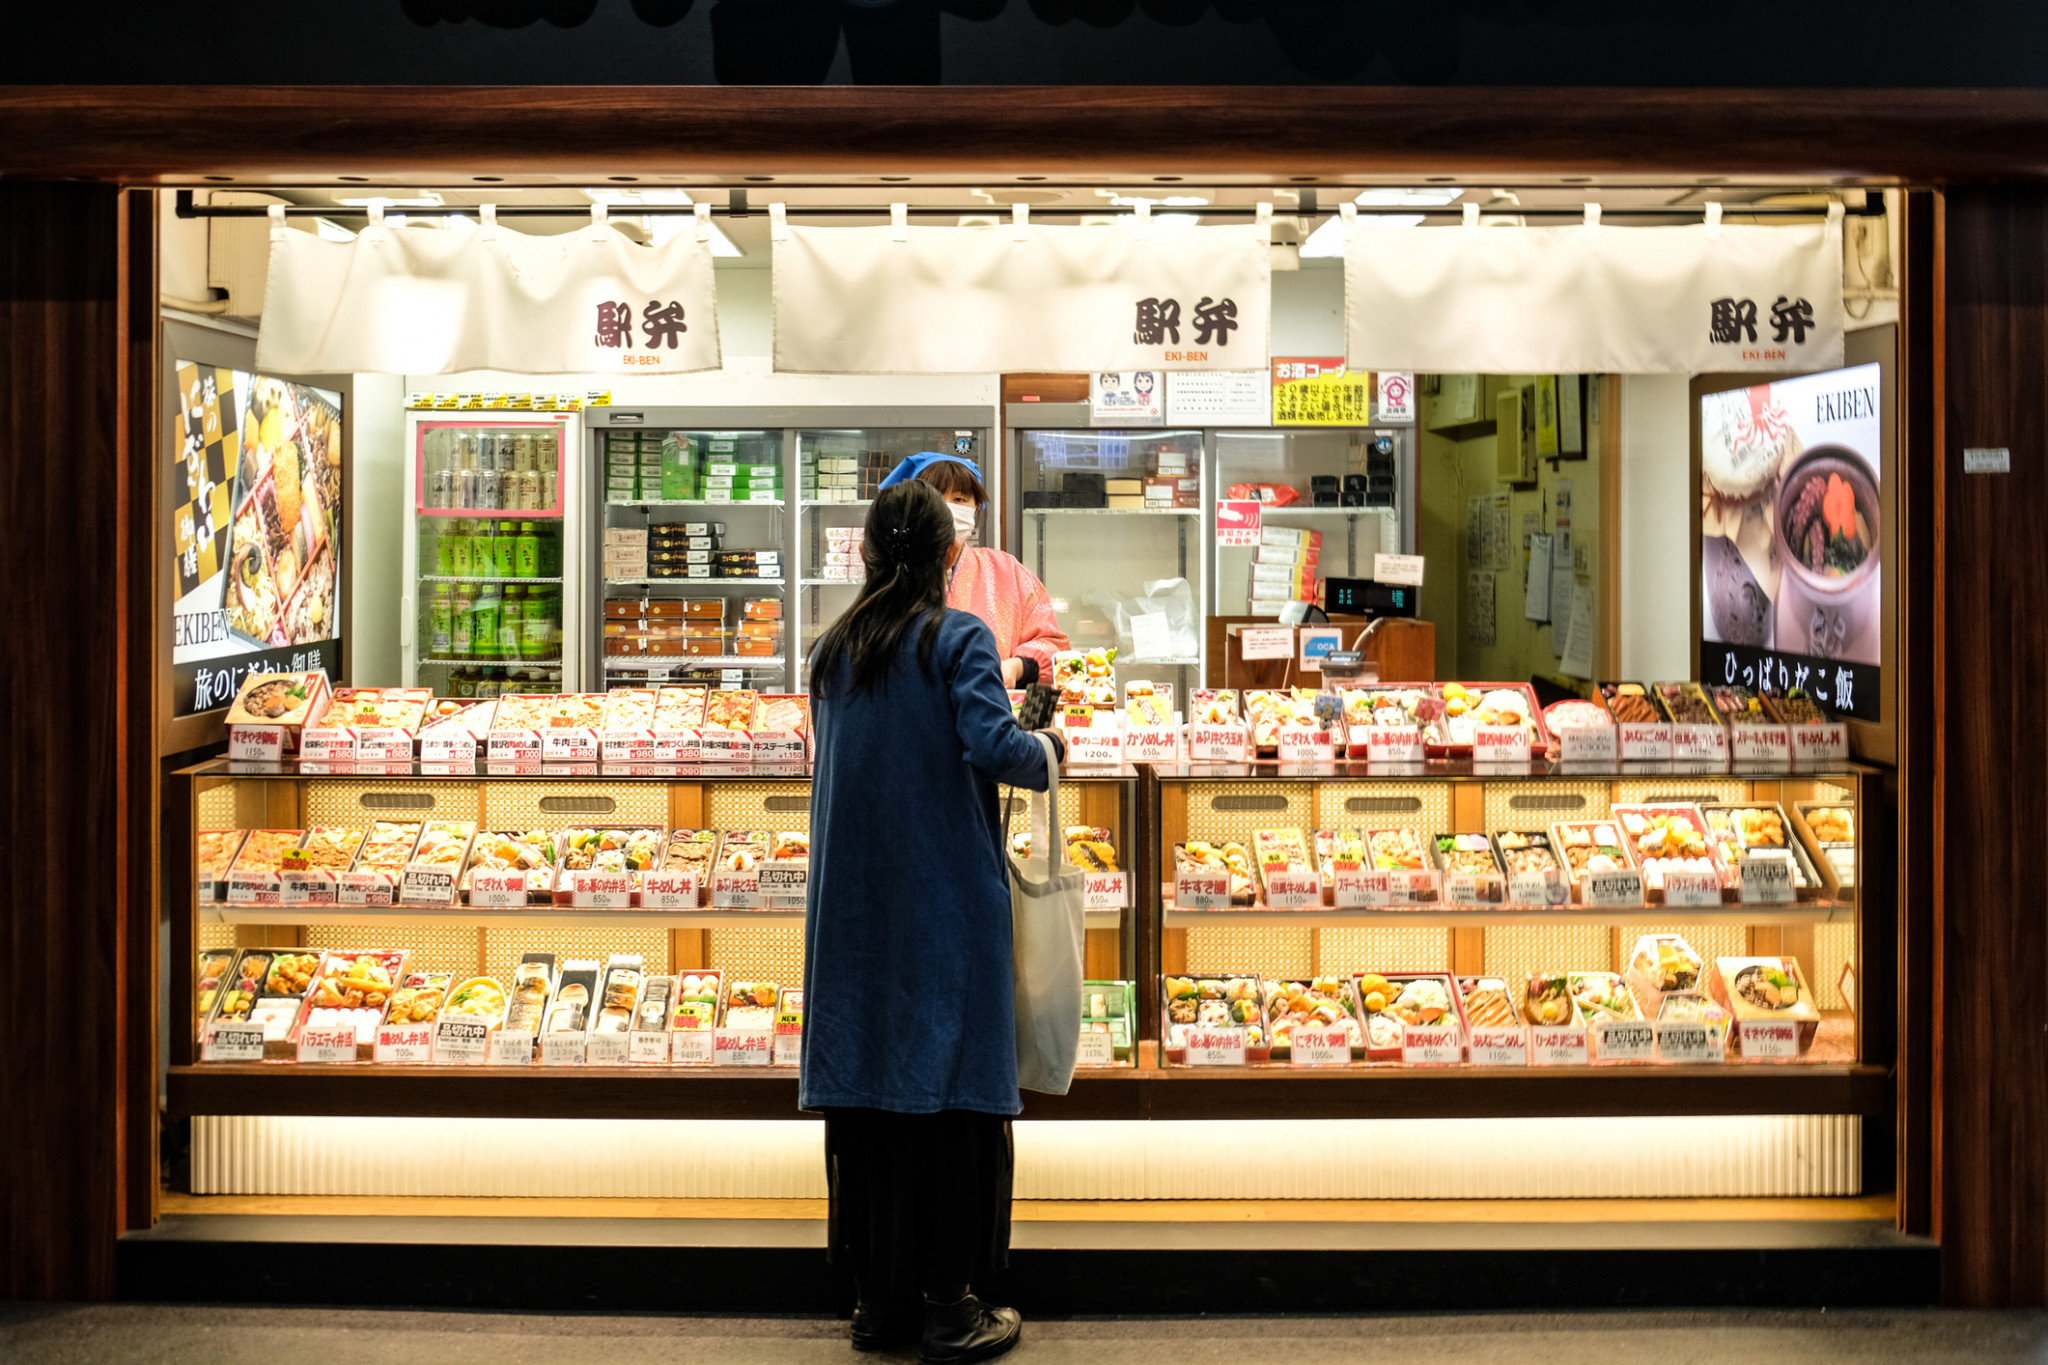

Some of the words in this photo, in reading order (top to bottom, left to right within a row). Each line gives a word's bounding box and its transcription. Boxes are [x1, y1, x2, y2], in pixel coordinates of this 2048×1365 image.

[595, 301, 688, 349] 駅弁
[1134, 297, 1238, 346] 駅弁
[1710, 298, 1815, 344] 駅弁
[624, 355, 660, 365] EKI-BEN
[1165, 352, 1208, 361] EKI-BEN
[1742, 351, 1785, 360] EKI-BEN
[1817, 386, 1875, 424] EKIBEN
[173, 608, 231, 648] EKIBEN
[1725, 652, 1853, 711] ひっぱりだこ飯
[1072, 737, 1119, 746] 春の二段重
[407, 873, 450, 886] 品切れ中
[761, 871, 805, 883] 品切れ中
[647, 879, 692, 894] 牛めし丼
[441, 1024, 485, 1037] 品切れ中
[217, 1032, 261, 1044] 品切れ中
[301, 1032, 352, 1047] バラエティ弁当
[681, 1050, 703, 1059] 940円
